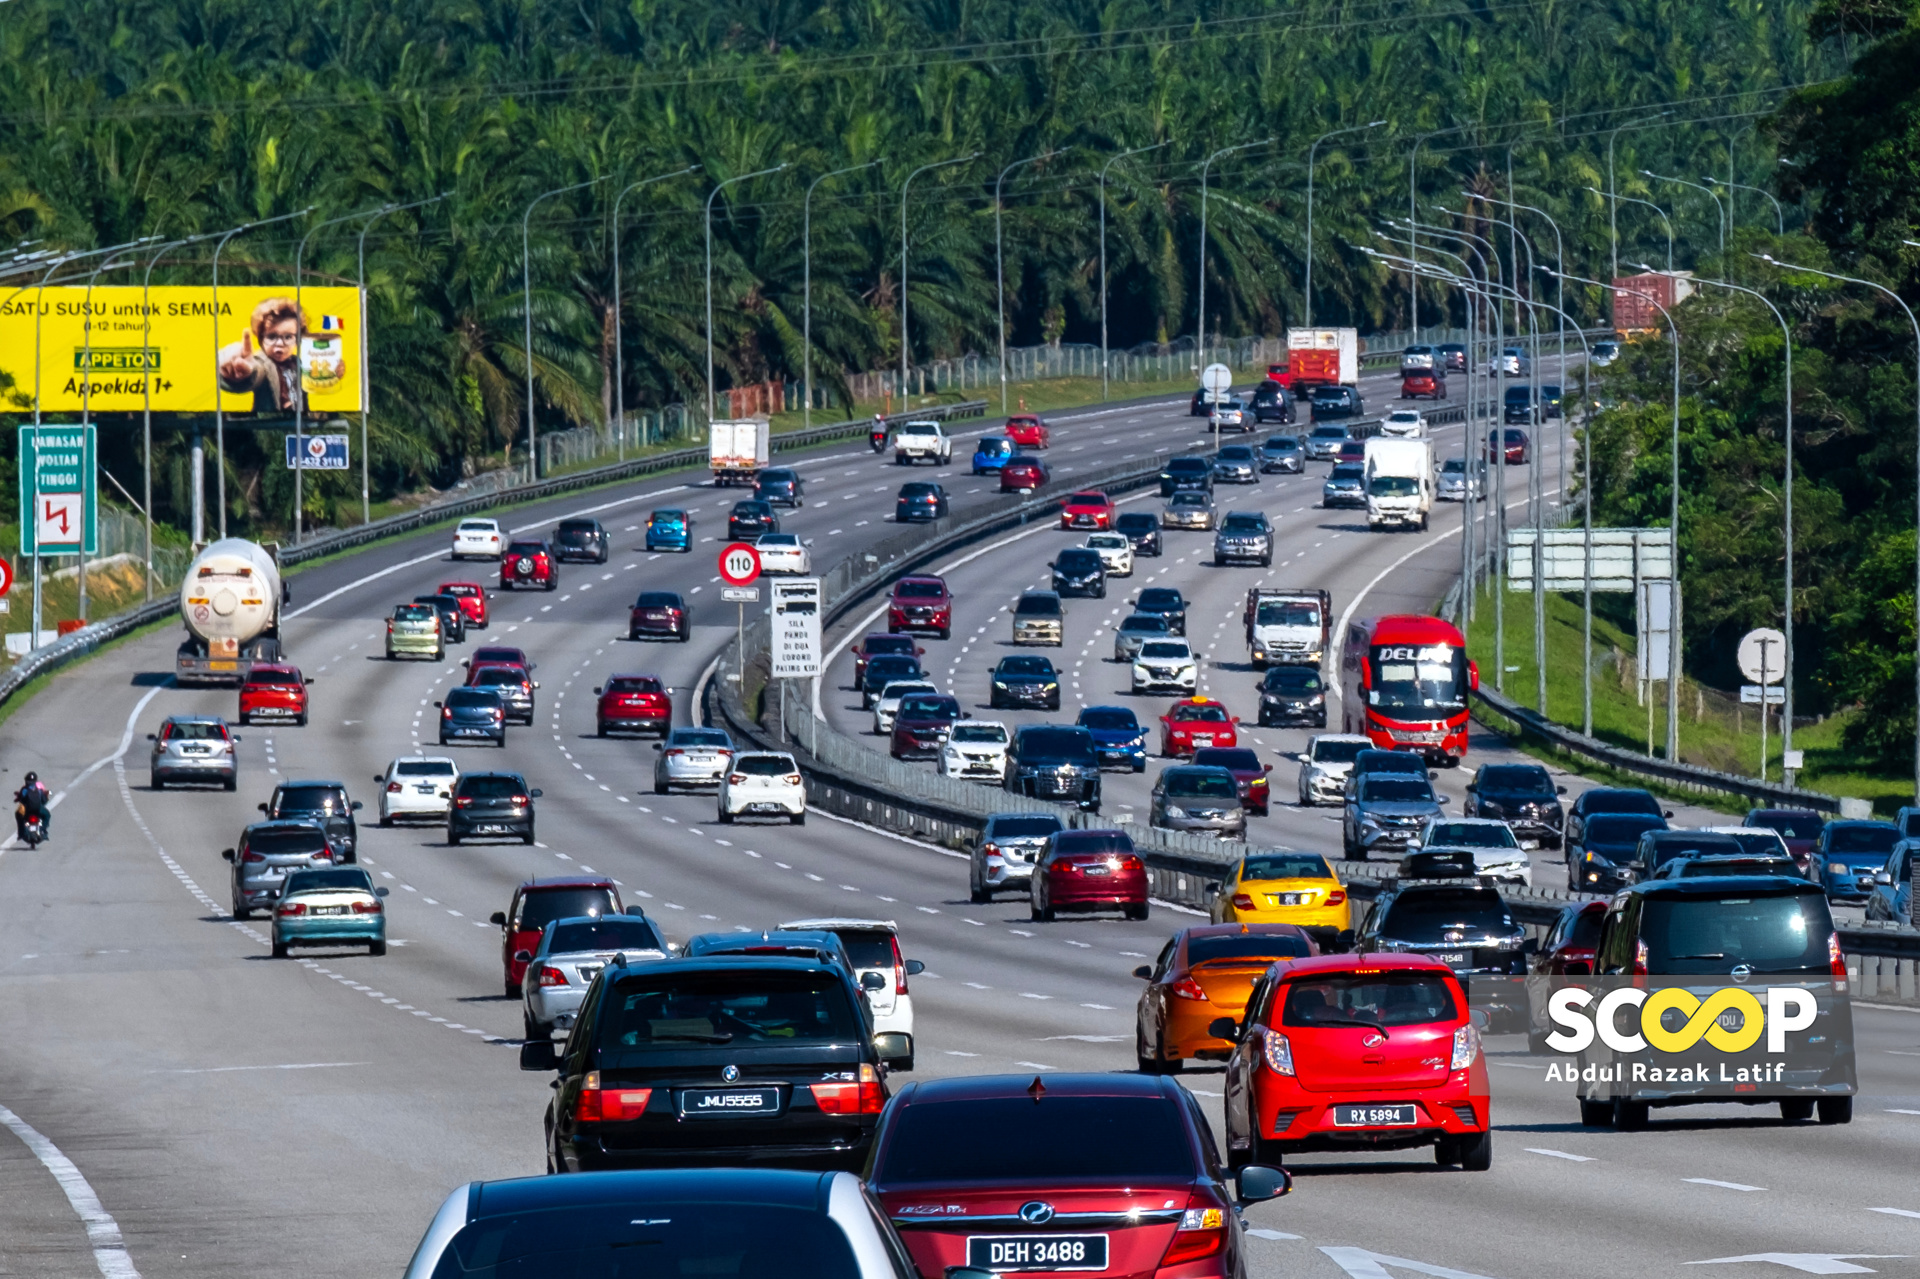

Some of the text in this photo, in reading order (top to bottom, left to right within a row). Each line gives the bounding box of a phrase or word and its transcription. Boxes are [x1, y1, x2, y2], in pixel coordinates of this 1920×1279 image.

[3, 301, 232, 316] SATU SUSU untuk SEMUA
[80, 352, 157, 368] APPETON
[155, 377, 172, 394] 1+
[40, 473, 77, 486] TINGGI
[730, 557, 751, 571] 110
[788, 620, 804, 628] SILA
[1351, 1109, 1401, 1122] RX 5894
[990, 1241, 1085, 1263] DEH 3488
